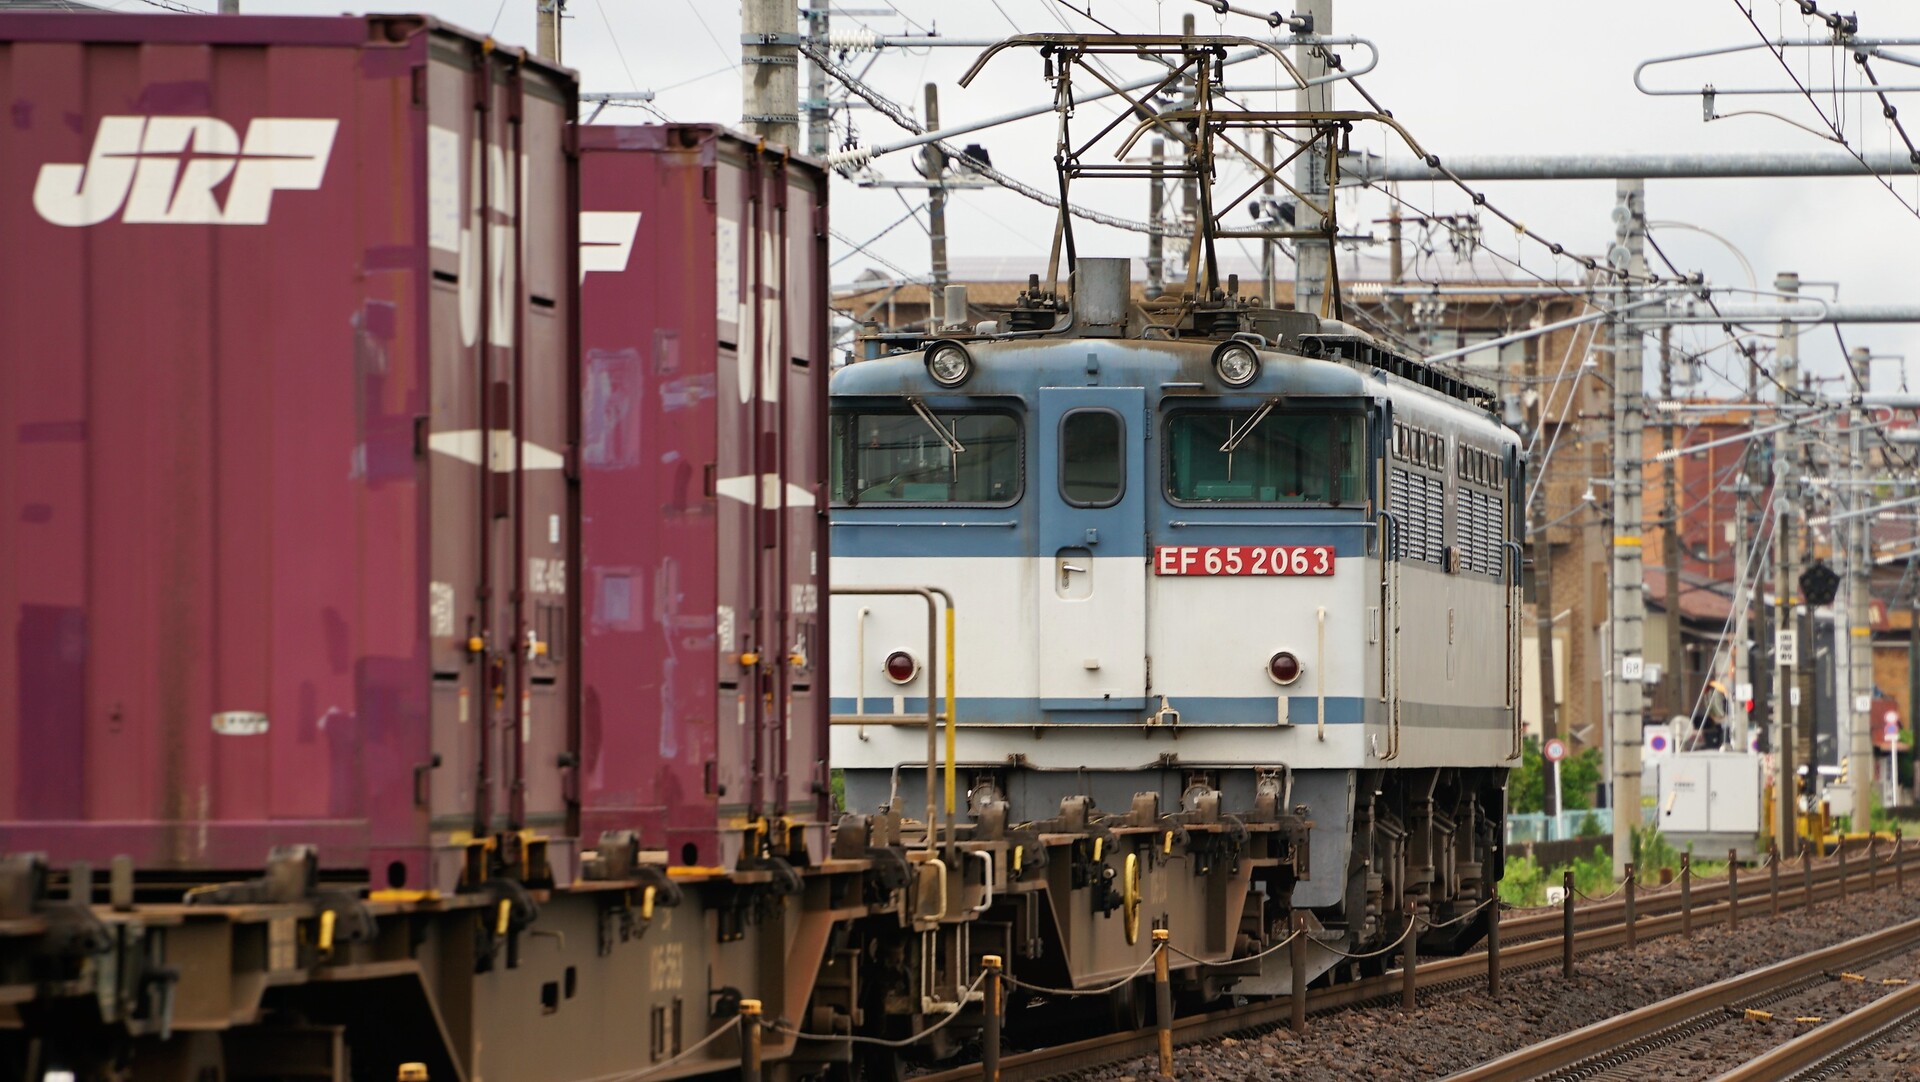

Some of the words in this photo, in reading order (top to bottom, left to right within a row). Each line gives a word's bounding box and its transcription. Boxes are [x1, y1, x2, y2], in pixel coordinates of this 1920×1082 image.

[33, 115, 339, 227] JRF
[1160, 547, 1198, 574] EF
[1204, 547, 1243, 574] 65
[1251, 547, 1329, 574] 2063
